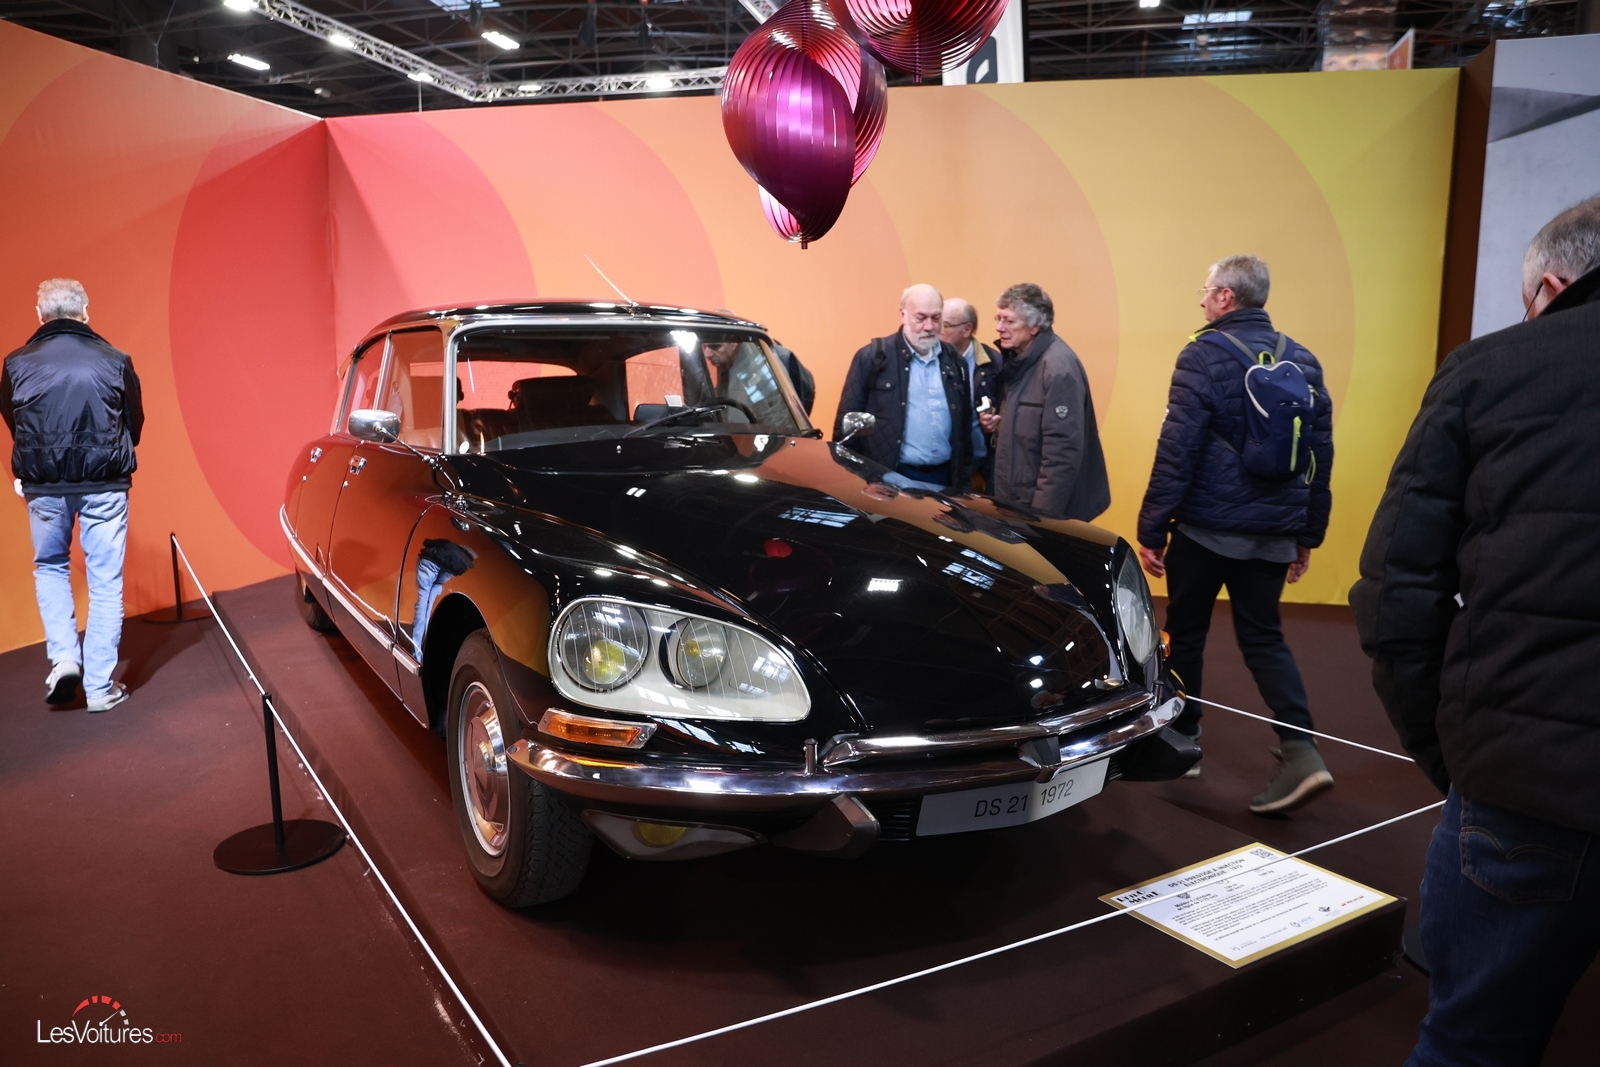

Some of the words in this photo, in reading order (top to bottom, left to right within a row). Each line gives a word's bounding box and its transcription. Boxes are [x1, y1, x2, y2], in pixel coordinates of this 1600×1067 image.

[974, 798, 1001, 818] DS
[1006, 794, 1028, 814] 21
[1041, 779, 1074, 806] 1972
